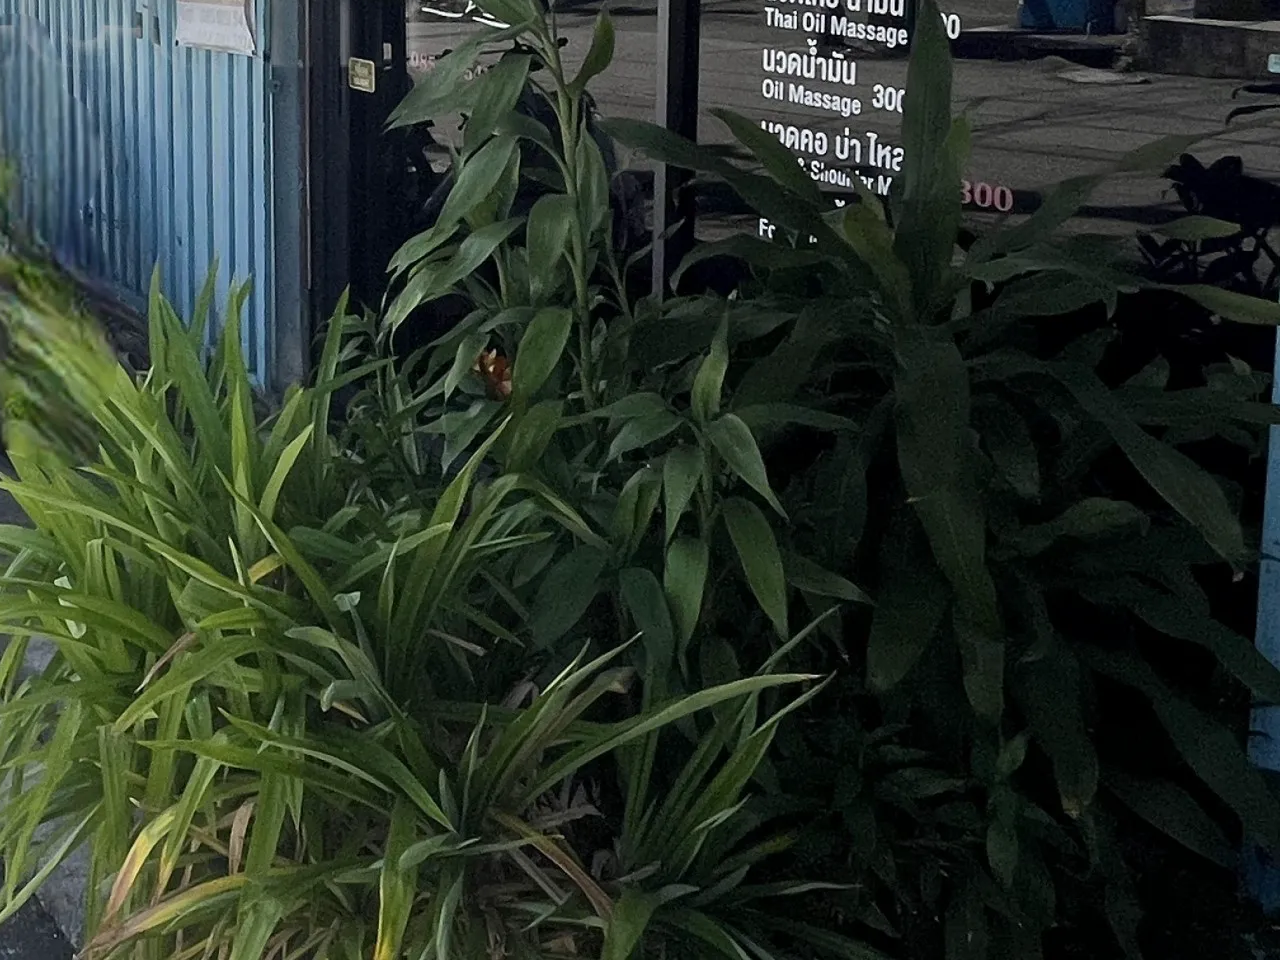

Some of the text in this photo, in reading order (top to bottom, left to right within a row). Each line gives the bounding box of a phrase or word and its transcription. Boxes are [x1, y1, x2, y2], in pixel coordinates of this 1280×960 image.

[764, 6, 908, 49] Thai Oil Massage
[762, 38, 857, 86] นวดน้ำมัน
[761, 78, 784, 101] Oil
[788, 84, 862, 117] Massage
